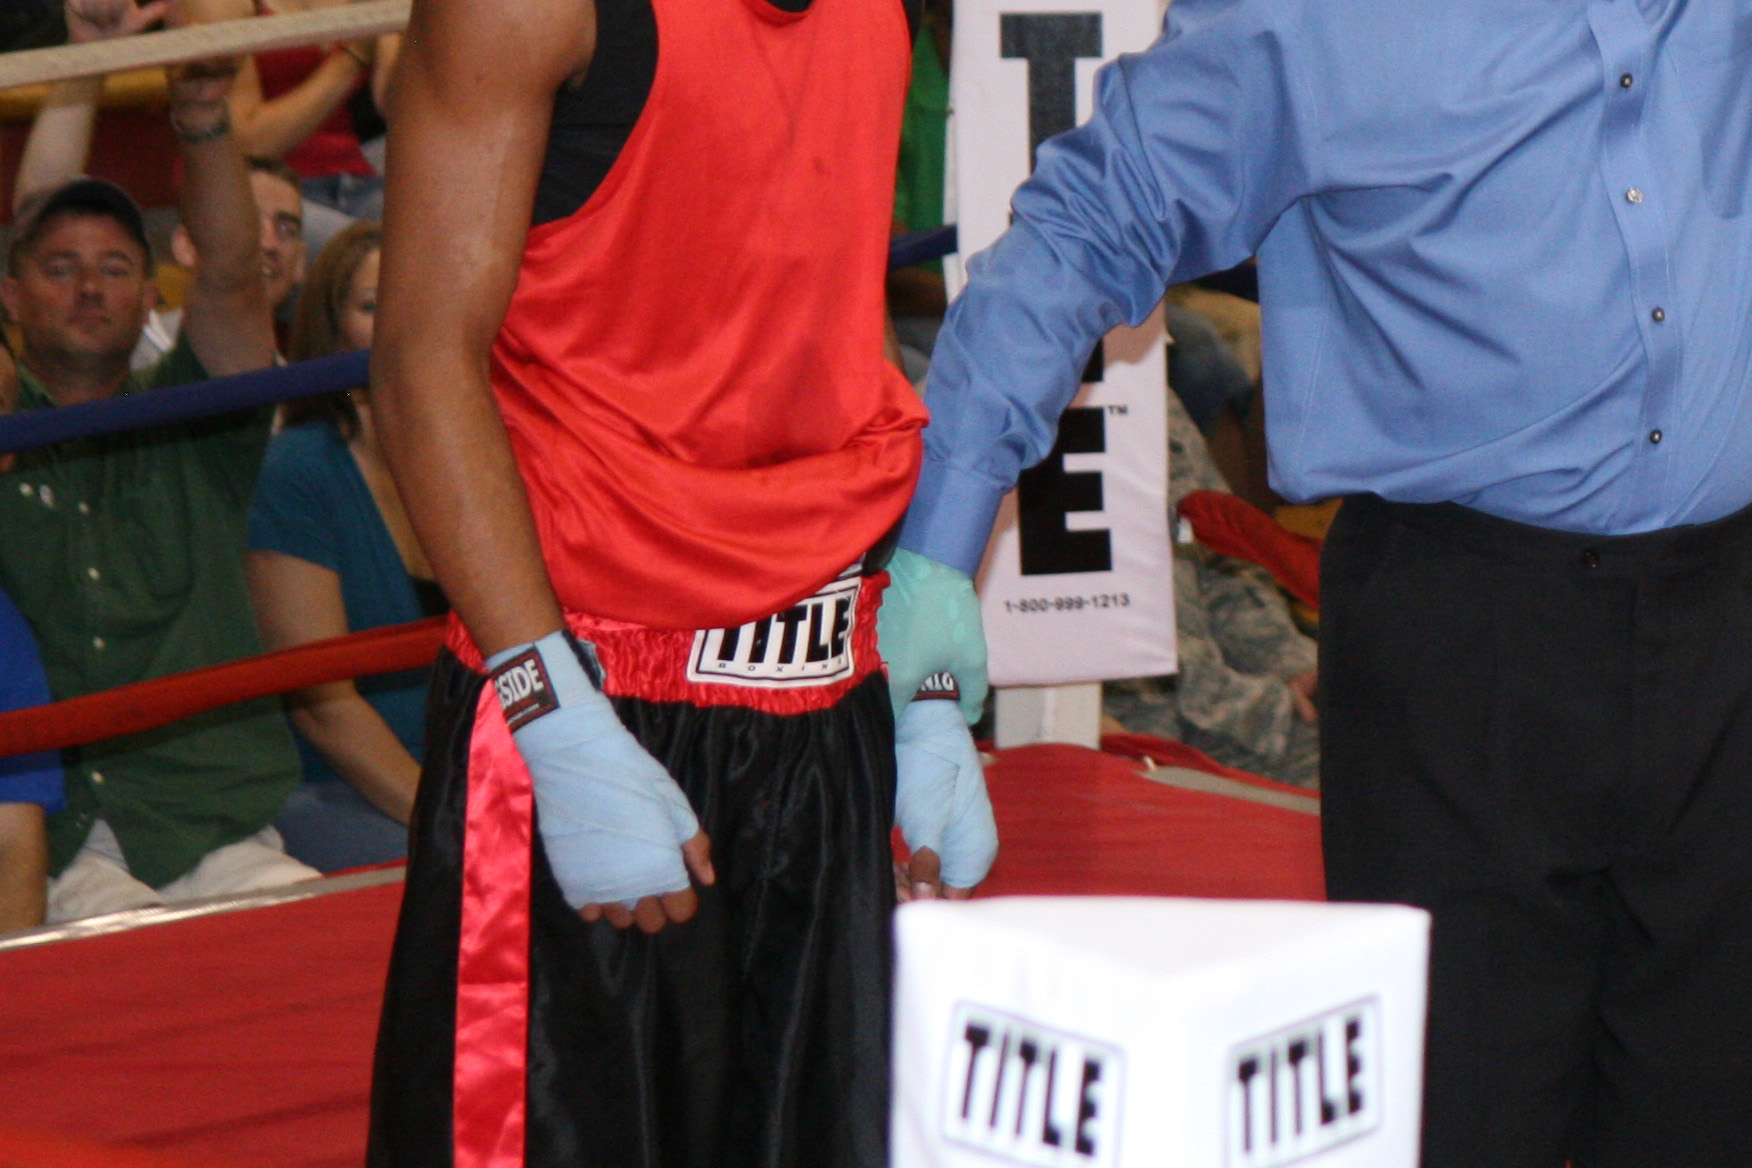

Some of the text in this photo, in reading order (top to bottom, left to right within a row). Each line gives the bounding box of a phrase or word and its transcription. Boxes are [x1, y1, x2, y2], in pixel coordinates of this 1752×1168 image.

[1004, 592, 1130, 613] 1-800-999-1213
[495, 658, 545, 710] SIDE
[961, 1022, 1104, 1158] TITLE
[1238, 1016, 1361, 1154] TITLE
